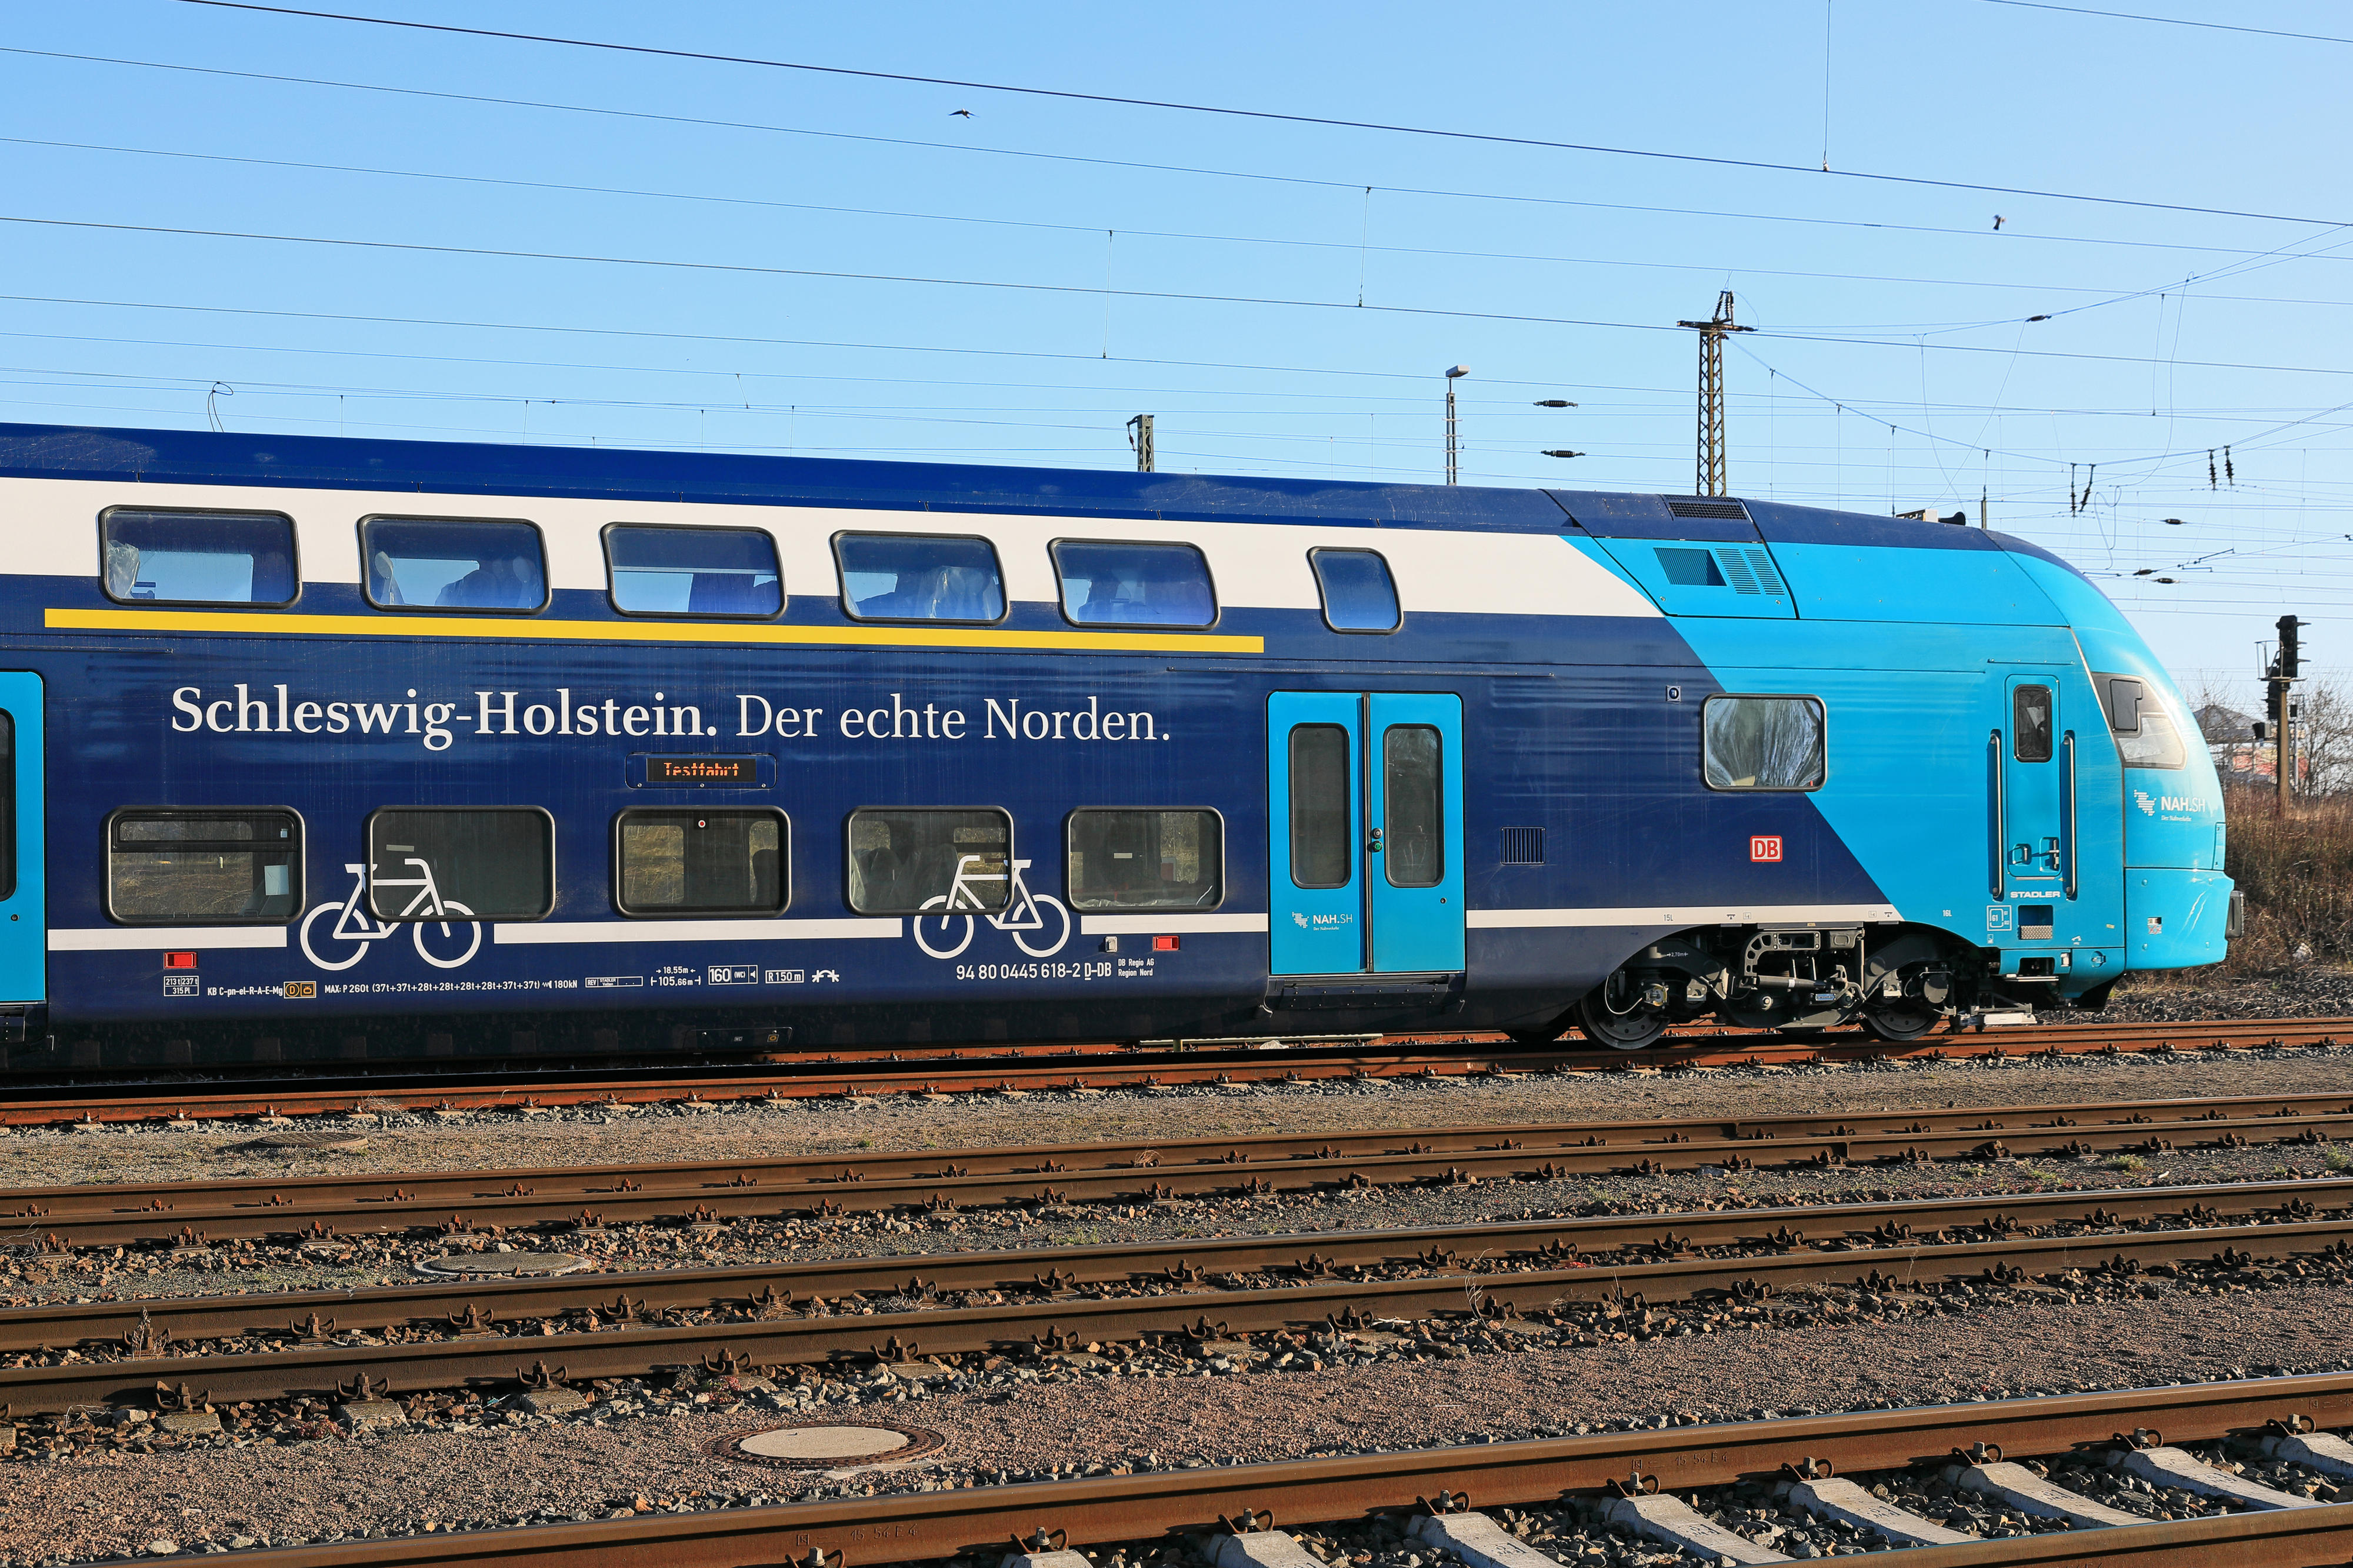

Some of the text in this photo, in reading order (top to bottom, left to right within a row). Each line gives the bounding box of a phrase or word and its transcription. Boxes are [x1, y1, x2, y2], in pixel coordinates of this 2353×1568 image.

[171, 683, 1170, 751] Schleswig-Holstein. Der echte Norden.
[664, 762, 739, 776] Testfahrt
[2161, 796, 2206, 813] NAH.SH
[1754, 840, 1779, 858] DB
[2010, 890, 2061, 899] STADLER
[1312, 913, 1353, 925] NAH.SH
[1118, 958, 1155, 968] DB Regio AG
[663, 966, 689, 974] 18,55m
[709, 968, 731, 982] 160
[734, 970, 746, 979] (WC)
[956, 962, 1112, 981] 94 80 0445 618-2 D-DB
[1118, 968, 1154, 977] Region Nord
[165, 978, 176, 986] 213
[658, 975, 694, 986] 105,66m
[768, 971, 774, 982] R
[775, 971, 792, 982] 150
[324, 984, 341, 993] MAX:
[343, 984, 348, 993] P
[349, 983, 369, 993] 260t
[554, 979, 578, 989] 180kN
[207, 985, 283, 997] KB C-pn-el-R-A-E-Mg
